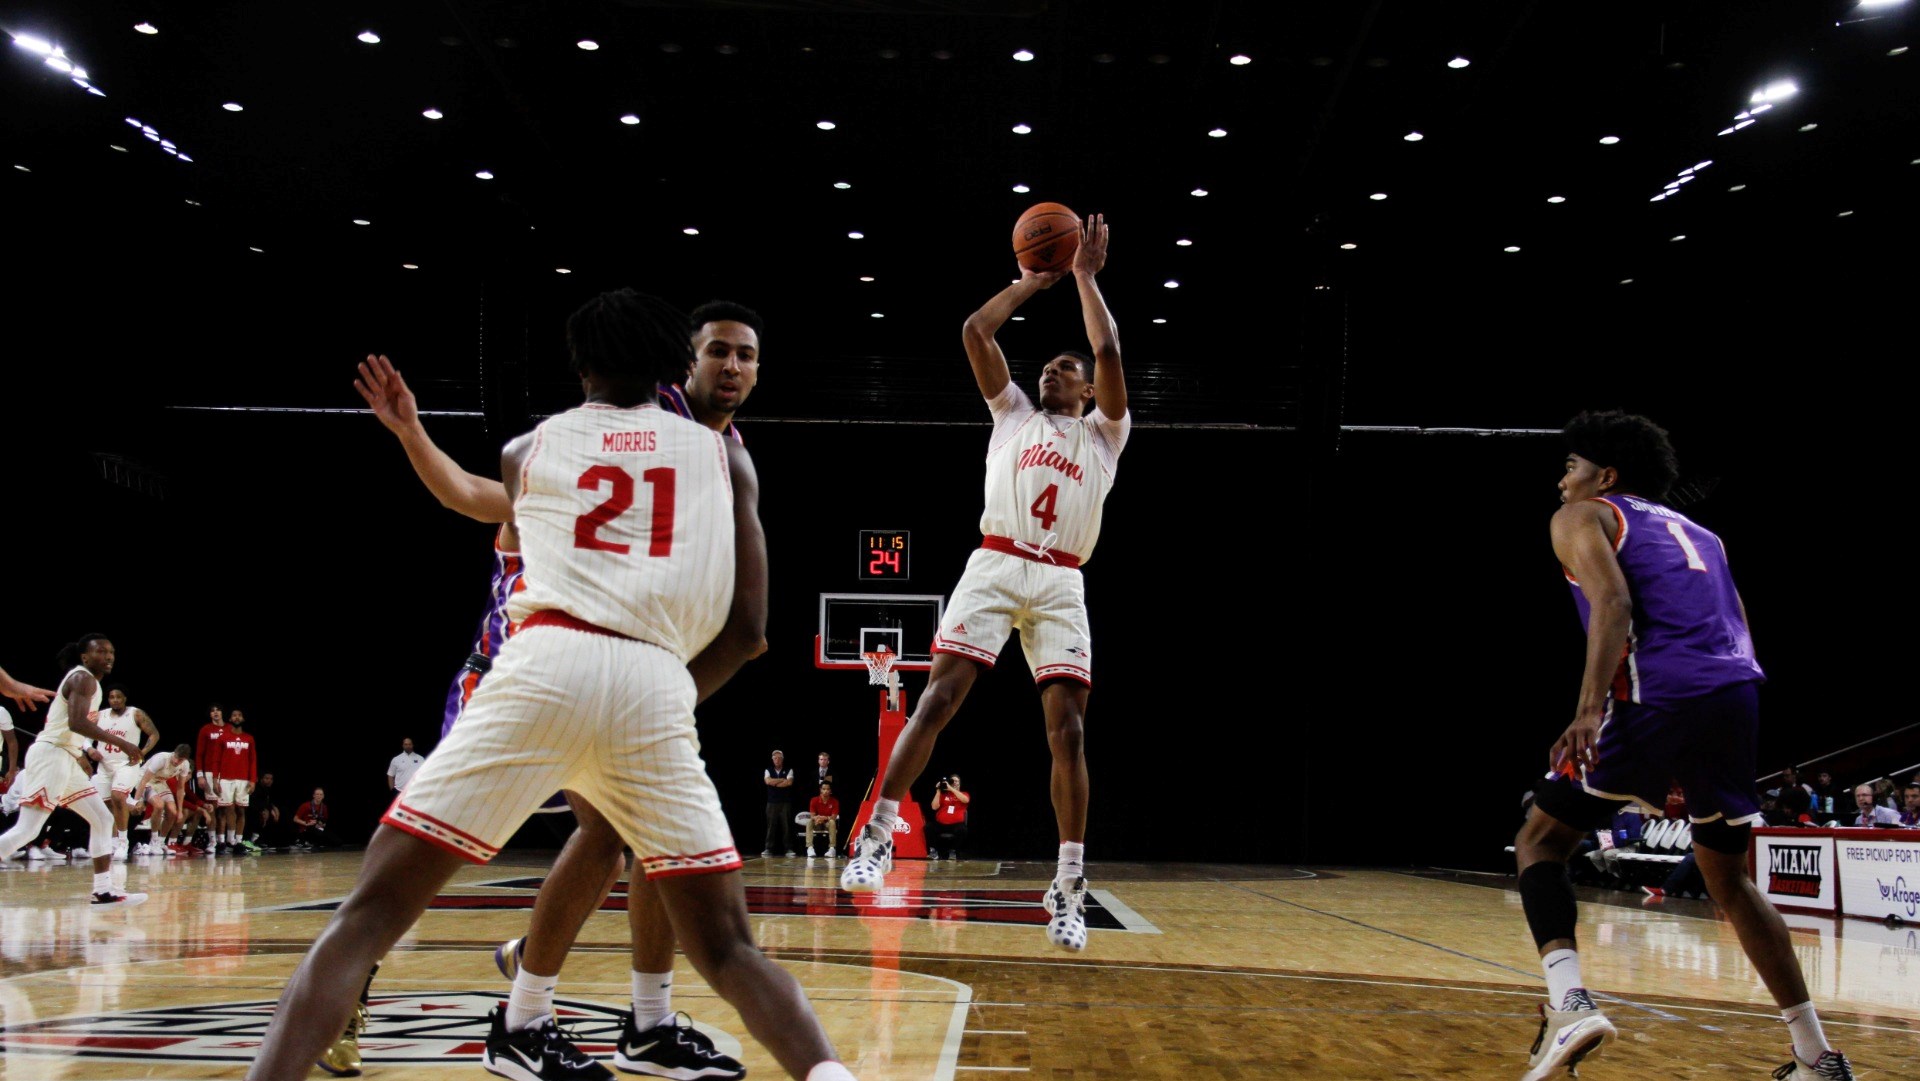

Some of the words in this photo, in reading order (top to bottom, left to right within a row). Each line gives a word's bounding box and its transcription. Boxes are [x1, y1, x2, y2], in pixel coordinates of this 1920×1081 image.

[602, 431, 656, 452] MORRIS
[573, 464, 676, 557] 21
[1030, 483, 1058, 531] 4
[1665, 521, 1707, 572] 1
[870, 550, 899, 574] 24
[226, 741, 249, 749] MIAMI
[1770, 848, 1819, 876] MIAMI
[1846, 847, 1864, 861] FREE
[1866, 848, 1893, 862] PICKUP
[1895, 849, 1912, 863] FOR
[1913, 849, 1920, 863] T
[1891, 875, 1920, 917] Kroge
